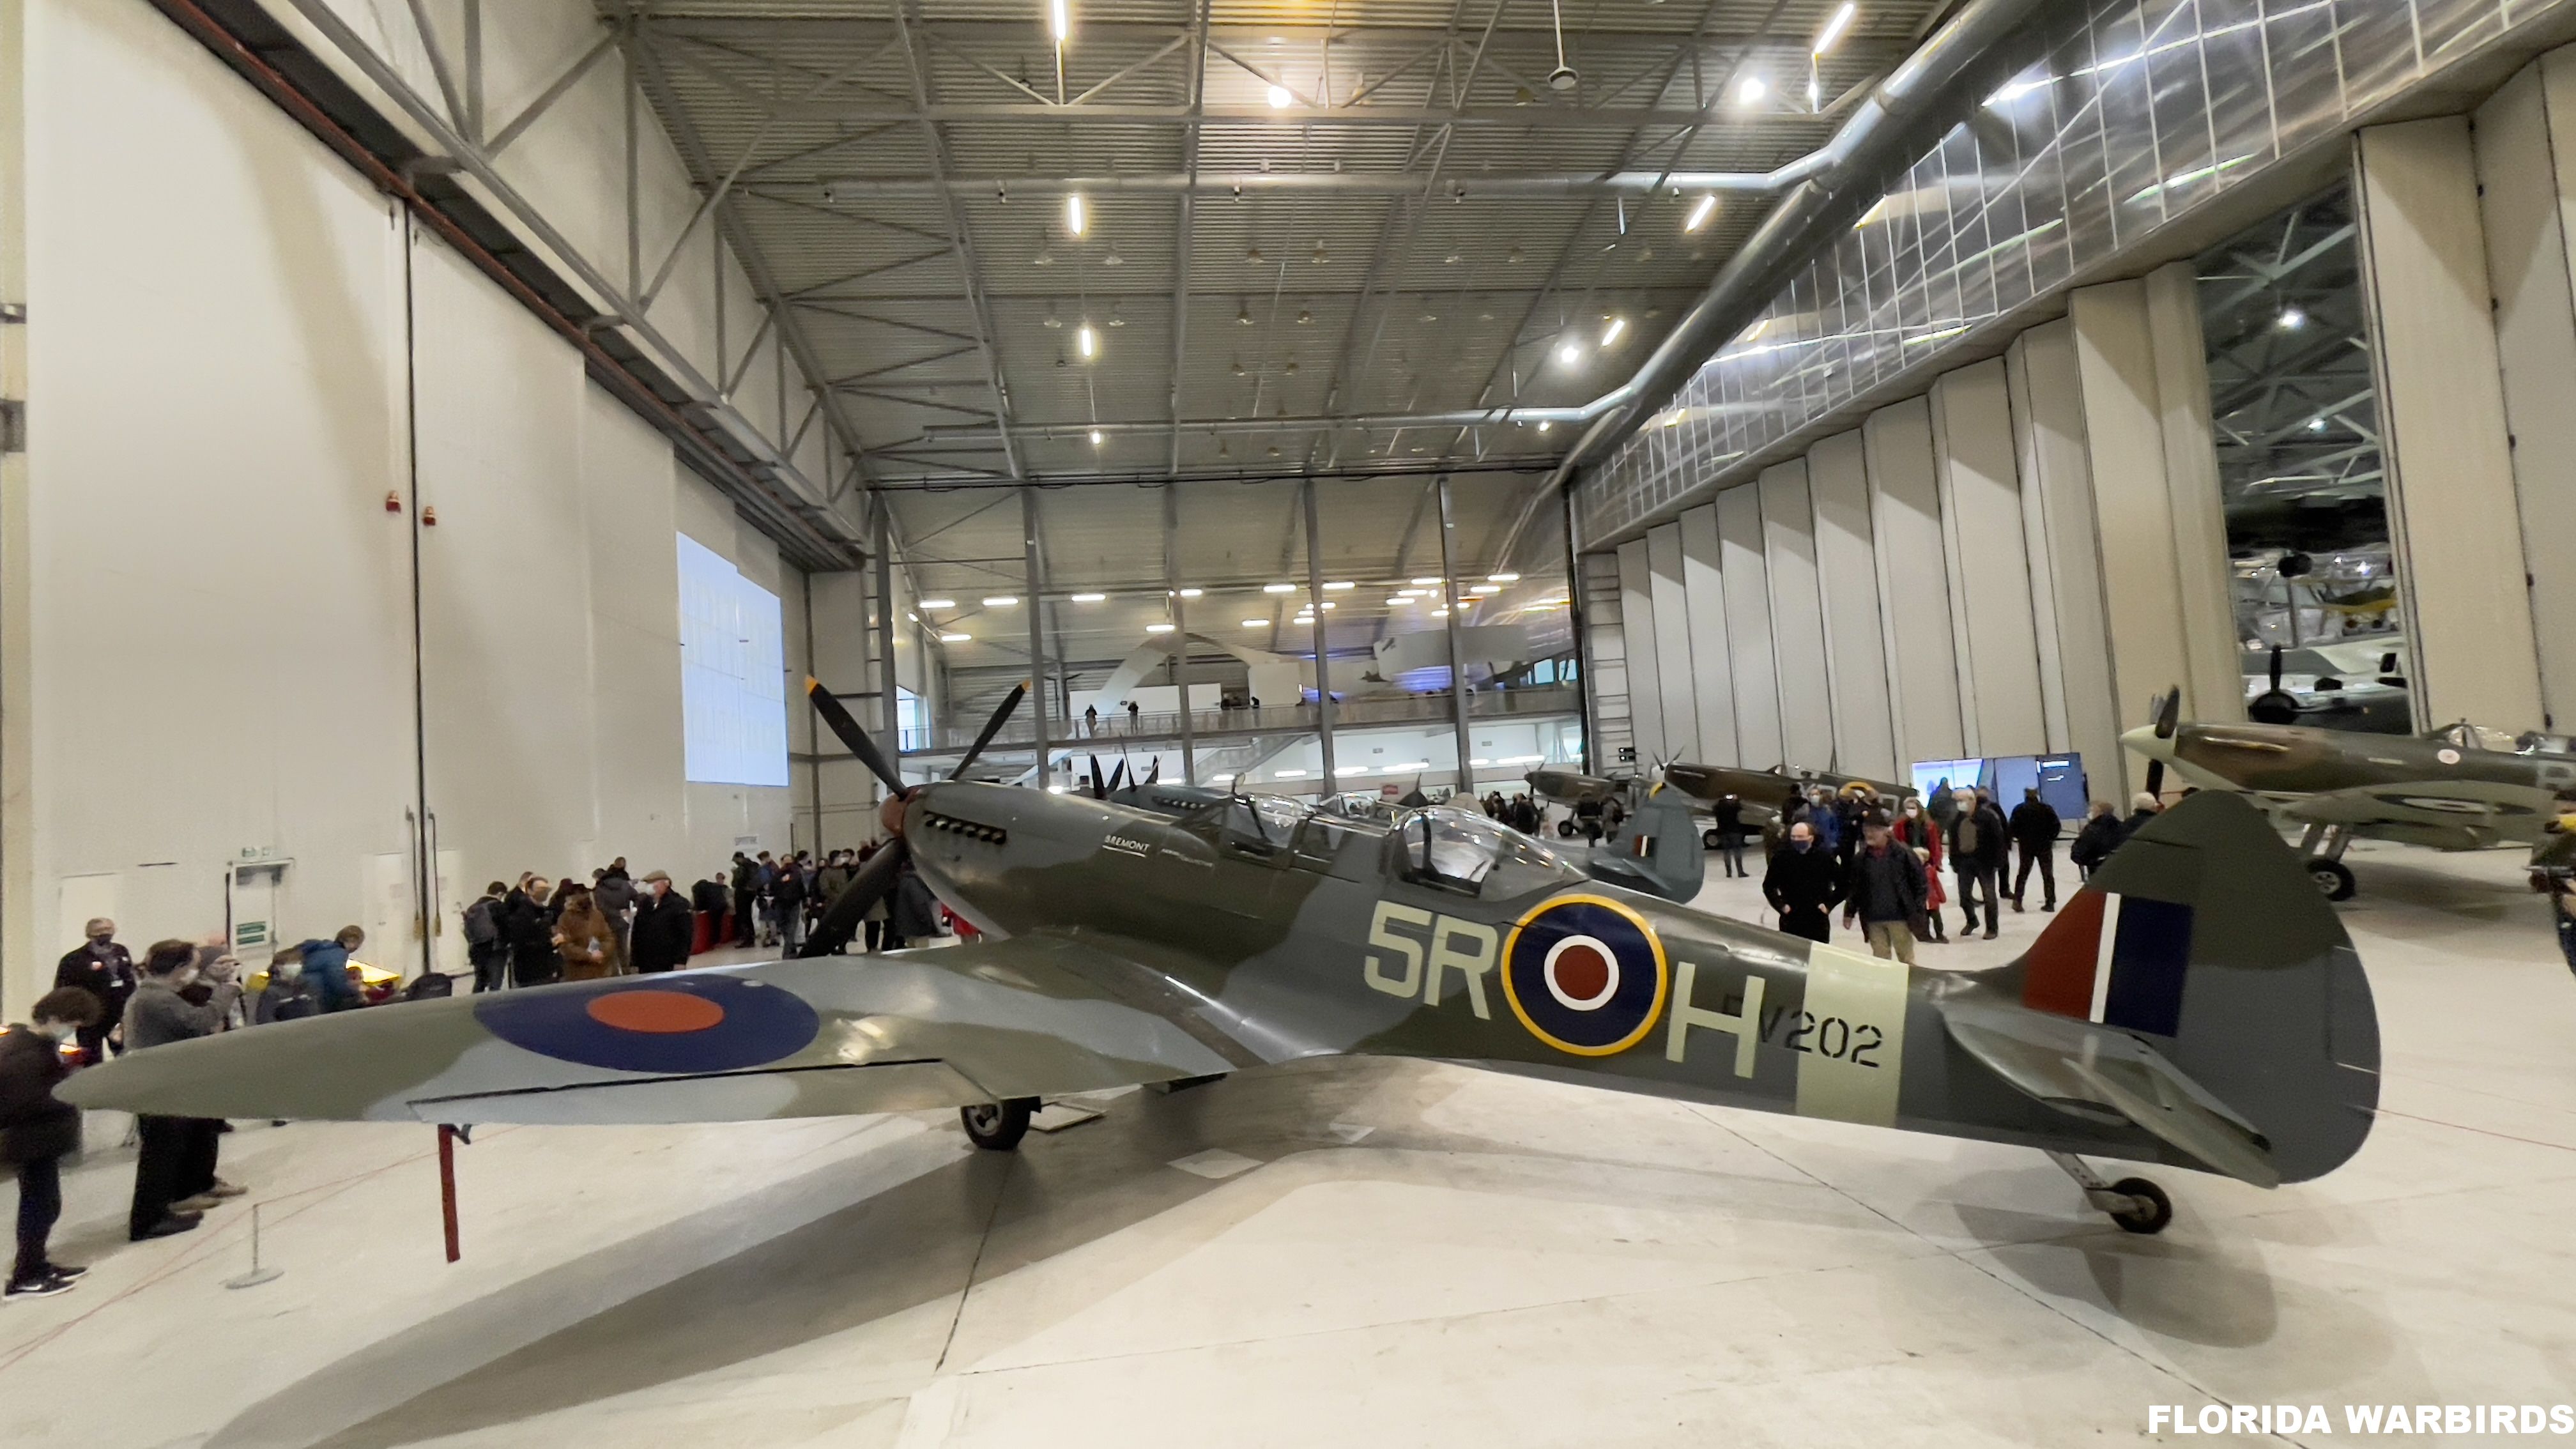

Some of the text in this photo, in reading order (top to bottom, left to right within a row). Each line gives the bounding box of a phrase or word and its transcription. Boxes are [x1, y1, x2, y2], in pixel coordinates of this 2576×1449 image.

[1105, 834, 1150, 852] BREMONT
[1364, 900, 1765, 1078] 5R H
